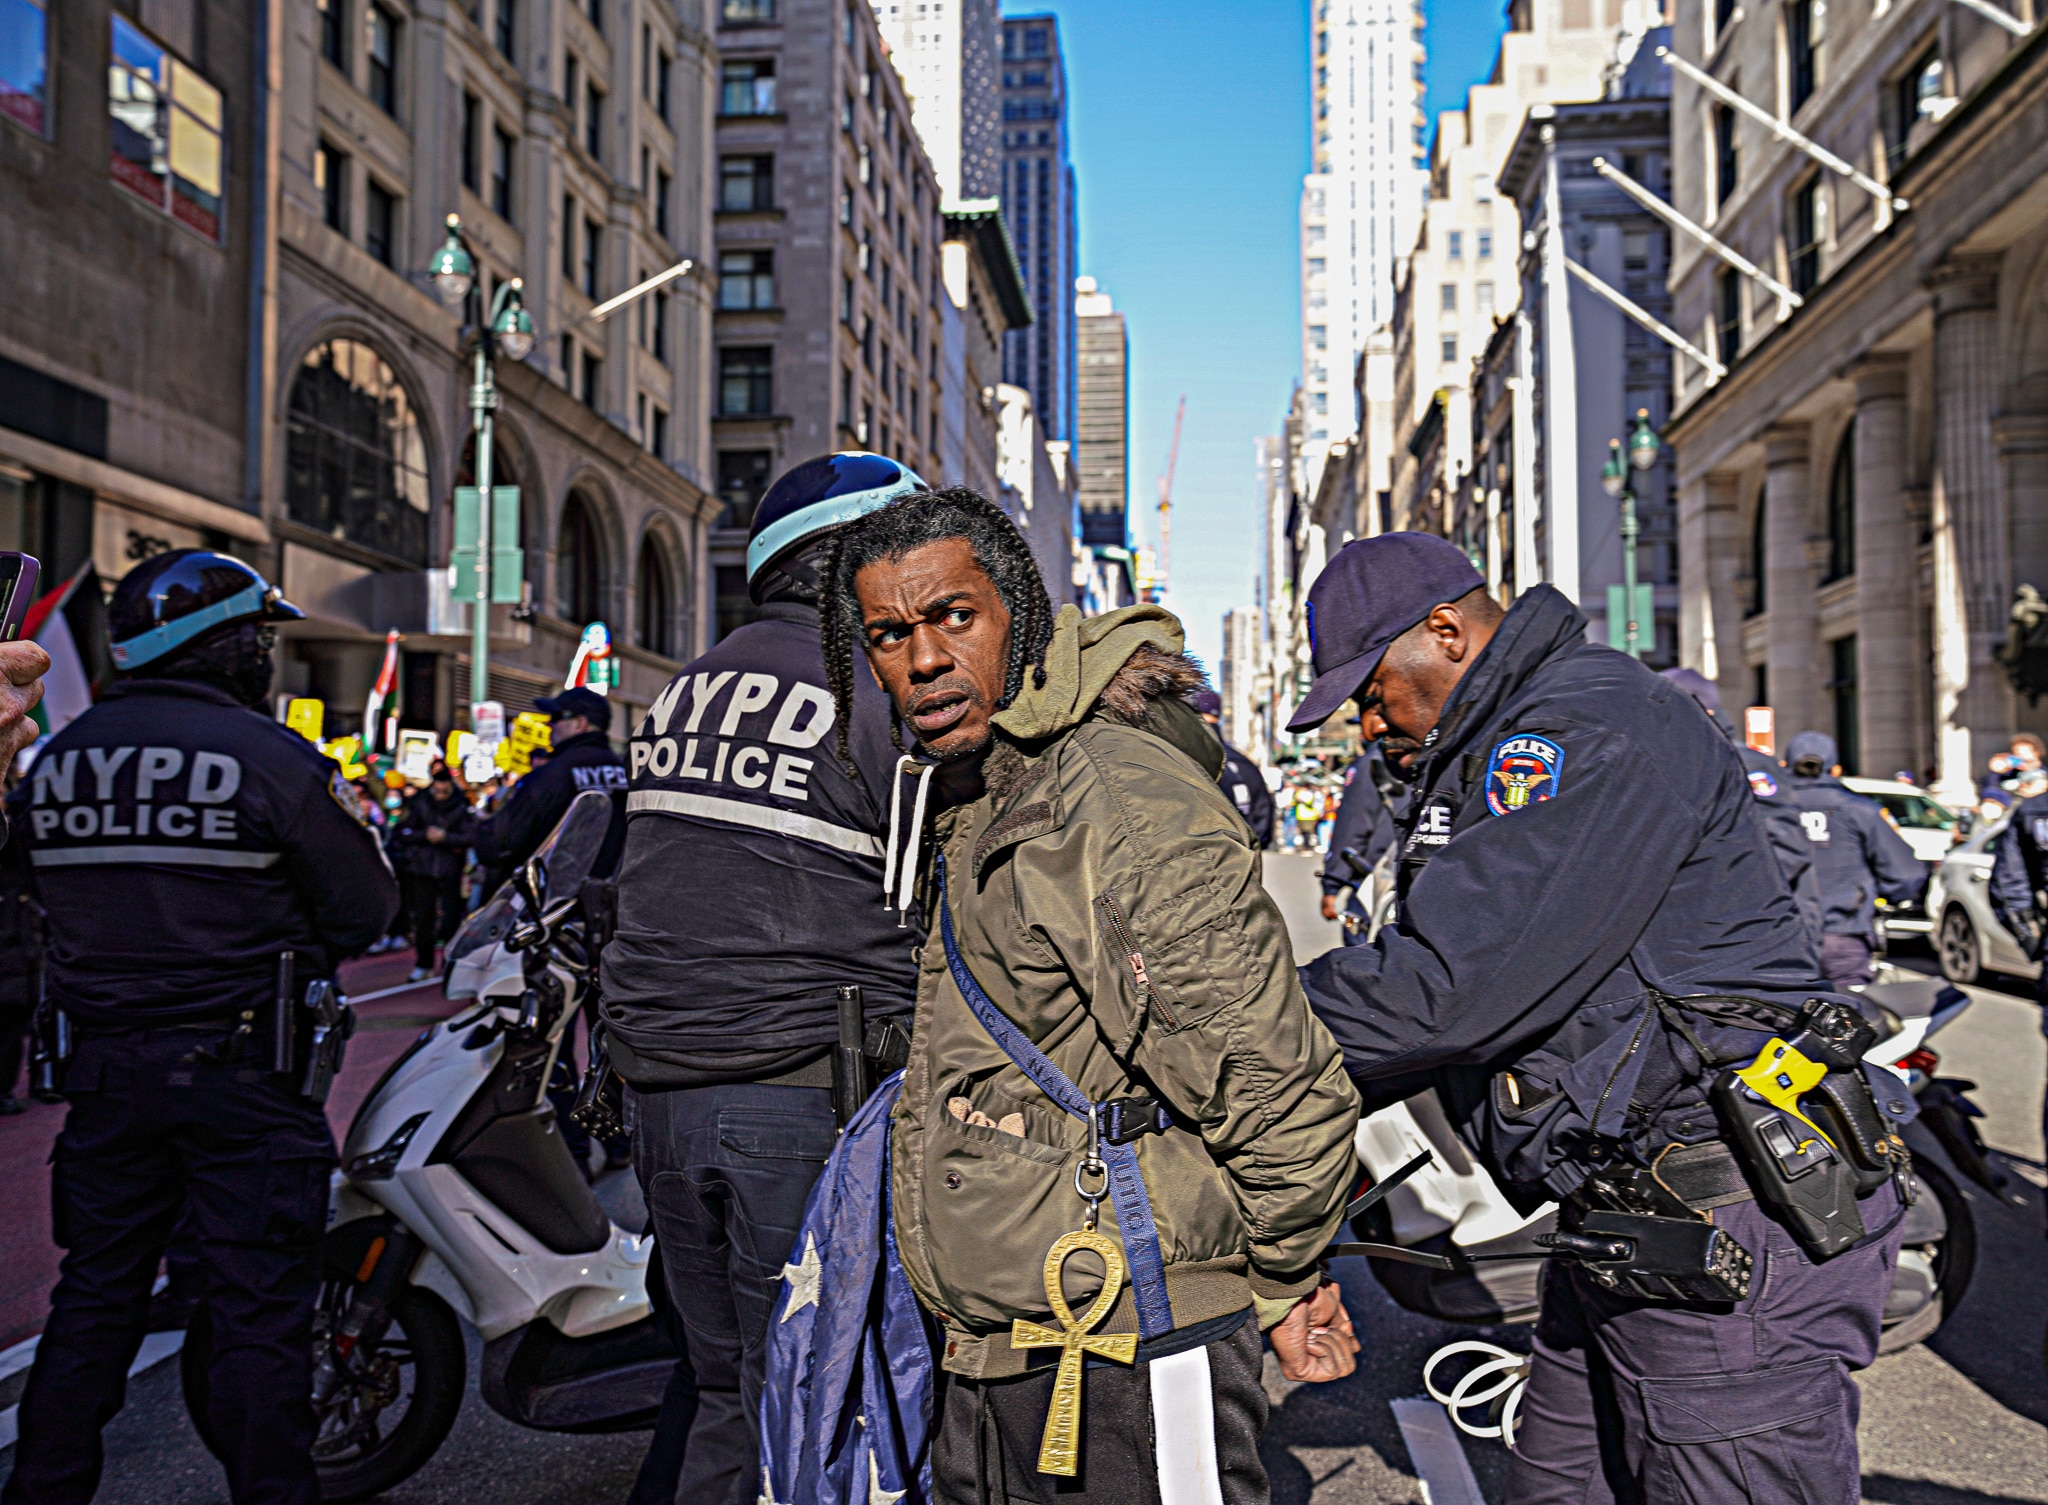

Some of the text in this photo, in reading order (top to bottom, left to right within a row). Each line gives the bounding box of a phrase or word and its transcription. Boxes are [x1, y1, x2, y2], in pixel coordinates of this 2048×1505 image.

[632, 671, 837, 749] NYPD
[630, 737, 814, 801] POLICE
[1498, 739, 1556, 764] POLICE
[33, 746, 242, 805] NYPD
[571, 765, 628, 787] NYPD
[31, 804, 238, 840] POLICE
